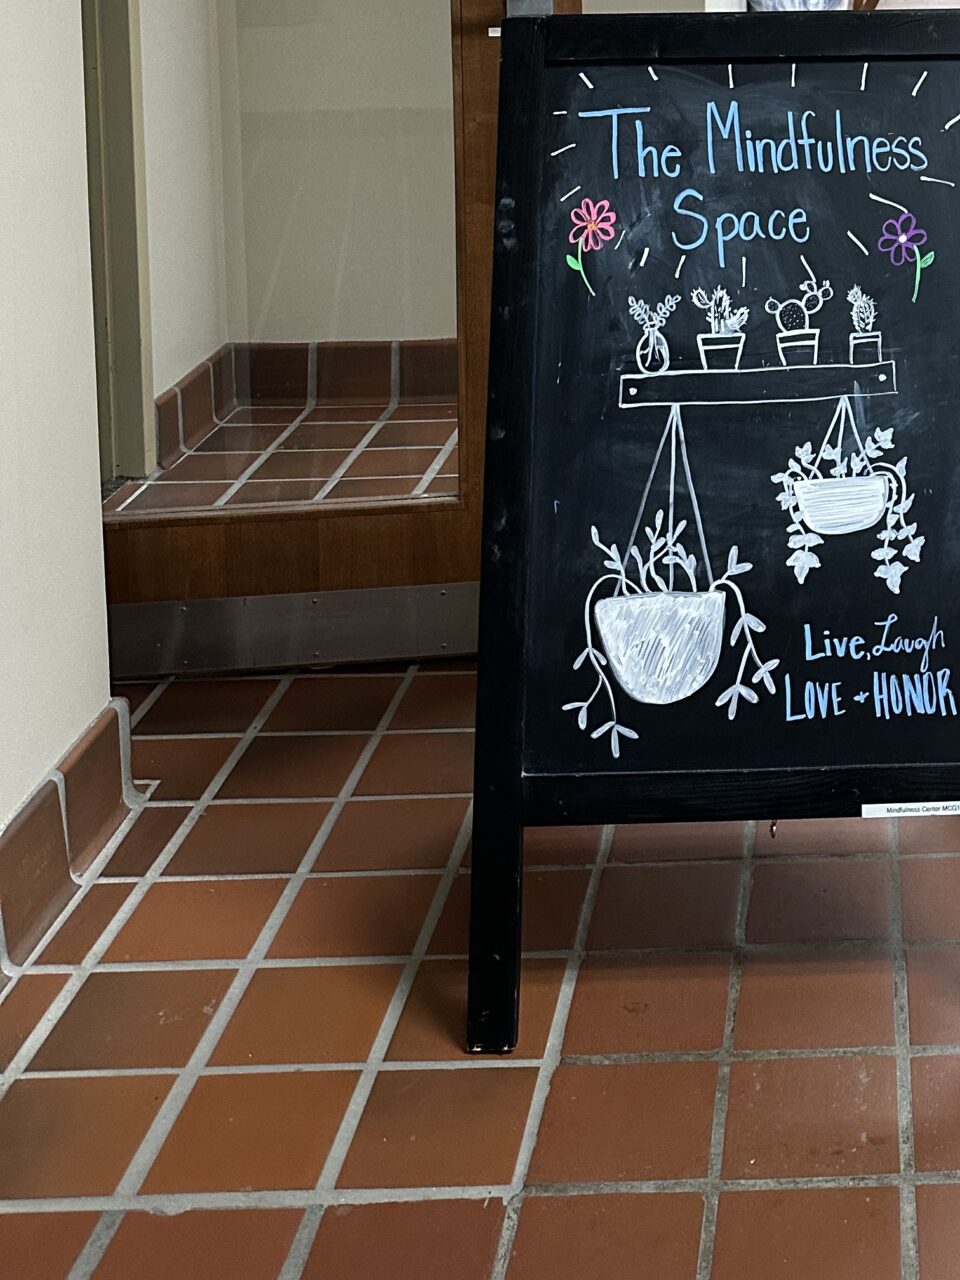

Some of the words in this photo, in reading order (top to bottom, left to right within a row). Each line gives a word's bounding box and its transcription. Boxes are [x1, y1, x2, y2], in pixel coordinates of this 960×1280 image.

[578, 106, 681, 180] The
[706, 100, 929, 174] Mindfulness
[671, 188, 810, 269] Space
[803, 622, 872, 661] Live,
[871, 613, 946, 673] Laugh
[784, 672, 847, 722] LOVE
[873, 668, 958, 720] HONOR
[886, 805, 920, 814] Mindfulness
[921, 804, 941, 813] Center
